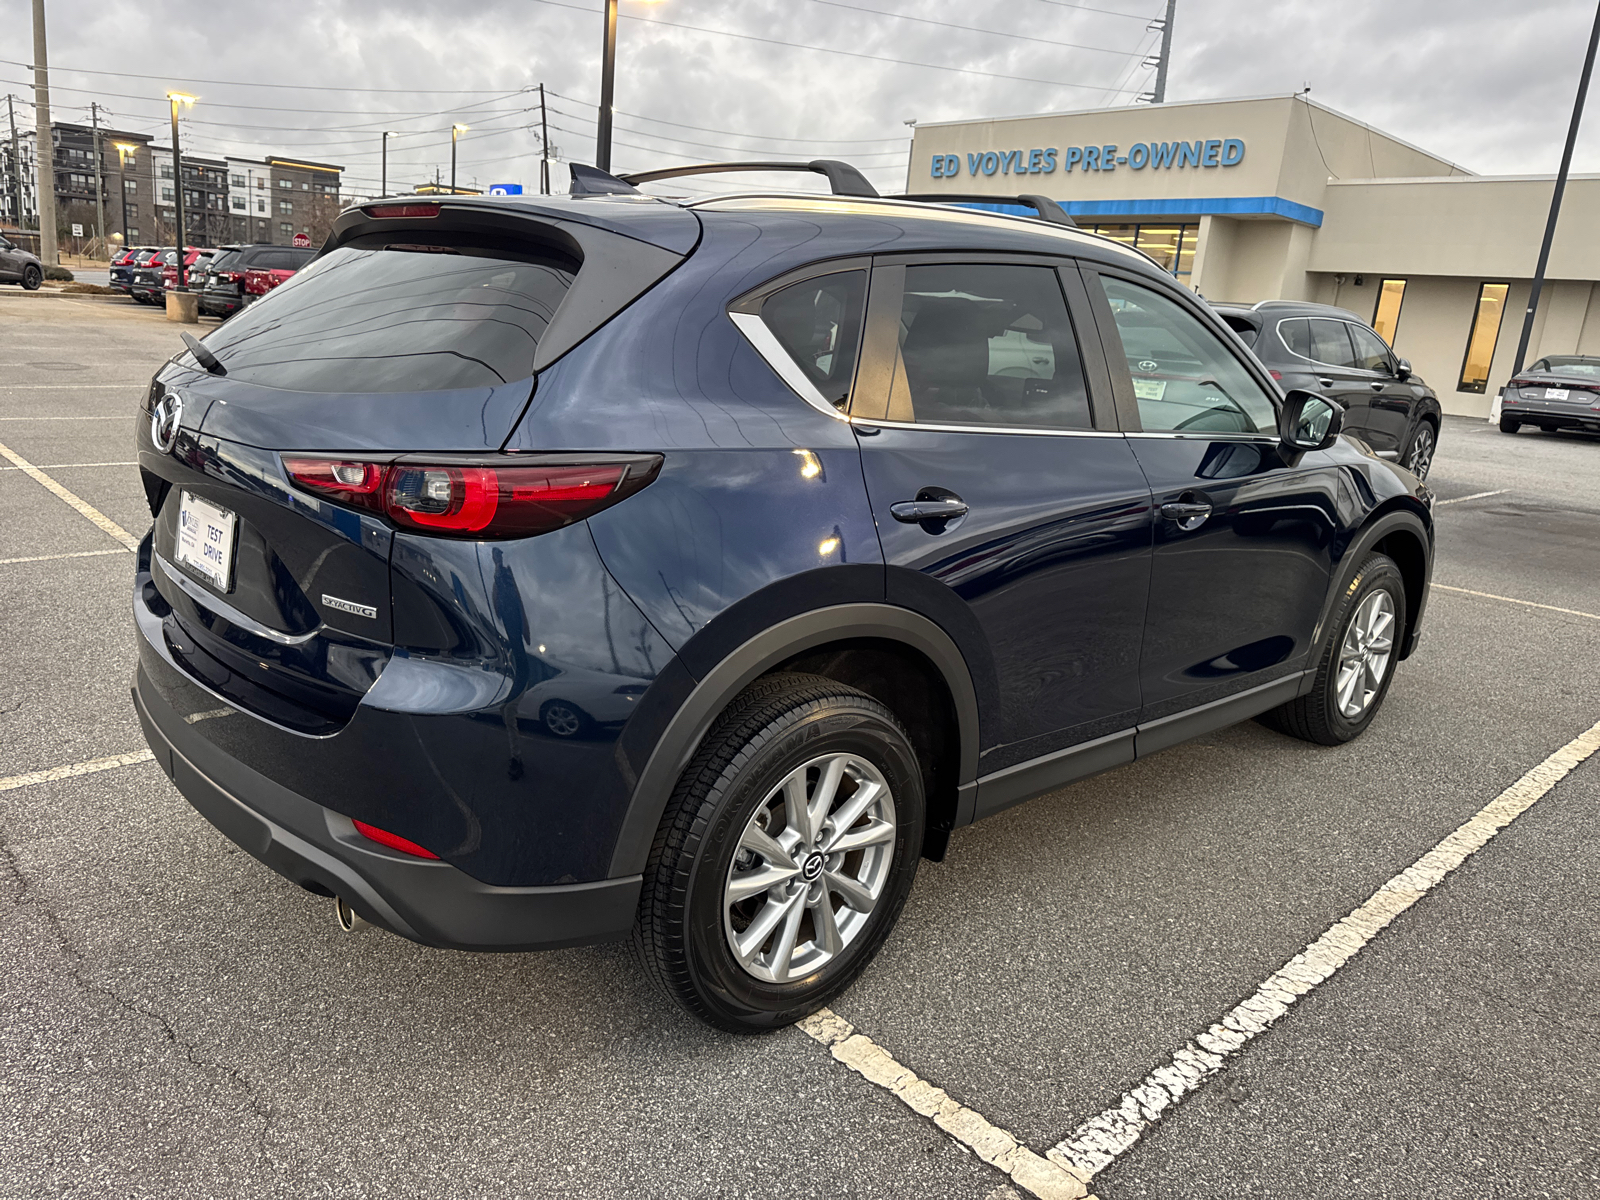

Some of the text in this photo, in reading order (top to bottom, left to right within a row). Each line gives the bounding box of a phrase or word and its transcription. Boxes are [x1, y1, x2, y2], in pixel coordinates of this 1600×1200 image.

[931, 138, 1246, 178] ED VOYLES PRE-OWNED
[294, 238, 310, 246] STOP
[207, 524, 223, 544] TEST
[203, 543, 223, 565] DRIVE
[703, 722, 821, 864] YOKOHAMA
